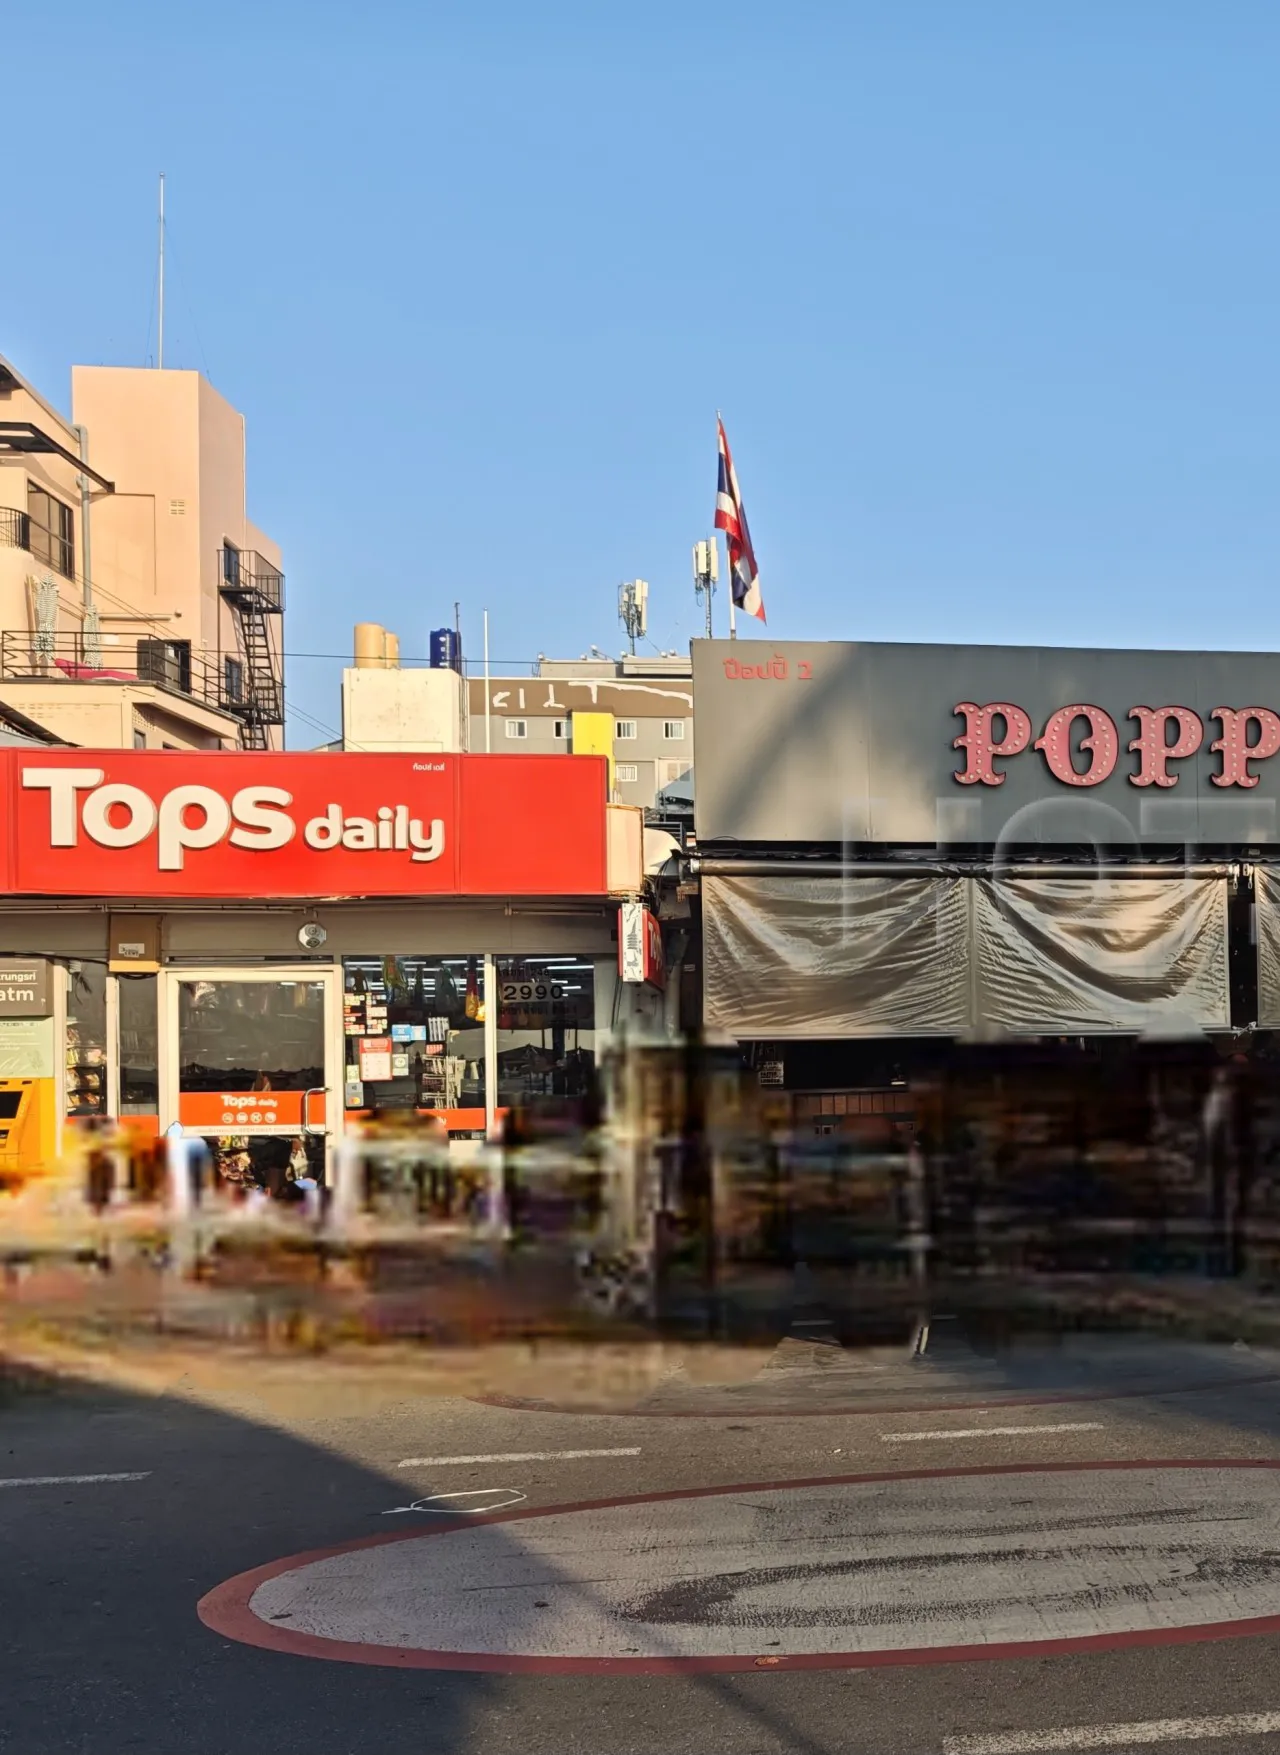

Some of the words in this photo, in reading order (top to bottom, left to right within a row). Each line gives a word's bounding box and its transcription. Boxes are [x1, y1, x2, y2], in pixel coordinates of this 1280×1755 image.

[798, 661, 813, 680] 2
[22, 768, 296, 871] Tops
[304, 803, 446, 862] daily
[0, 972, 36, 983] rungsri
[0, 987, 34, 1002] atm
[503, 985, 564, 1001] 2990
[221, 1094, 257, 1108] Tops
